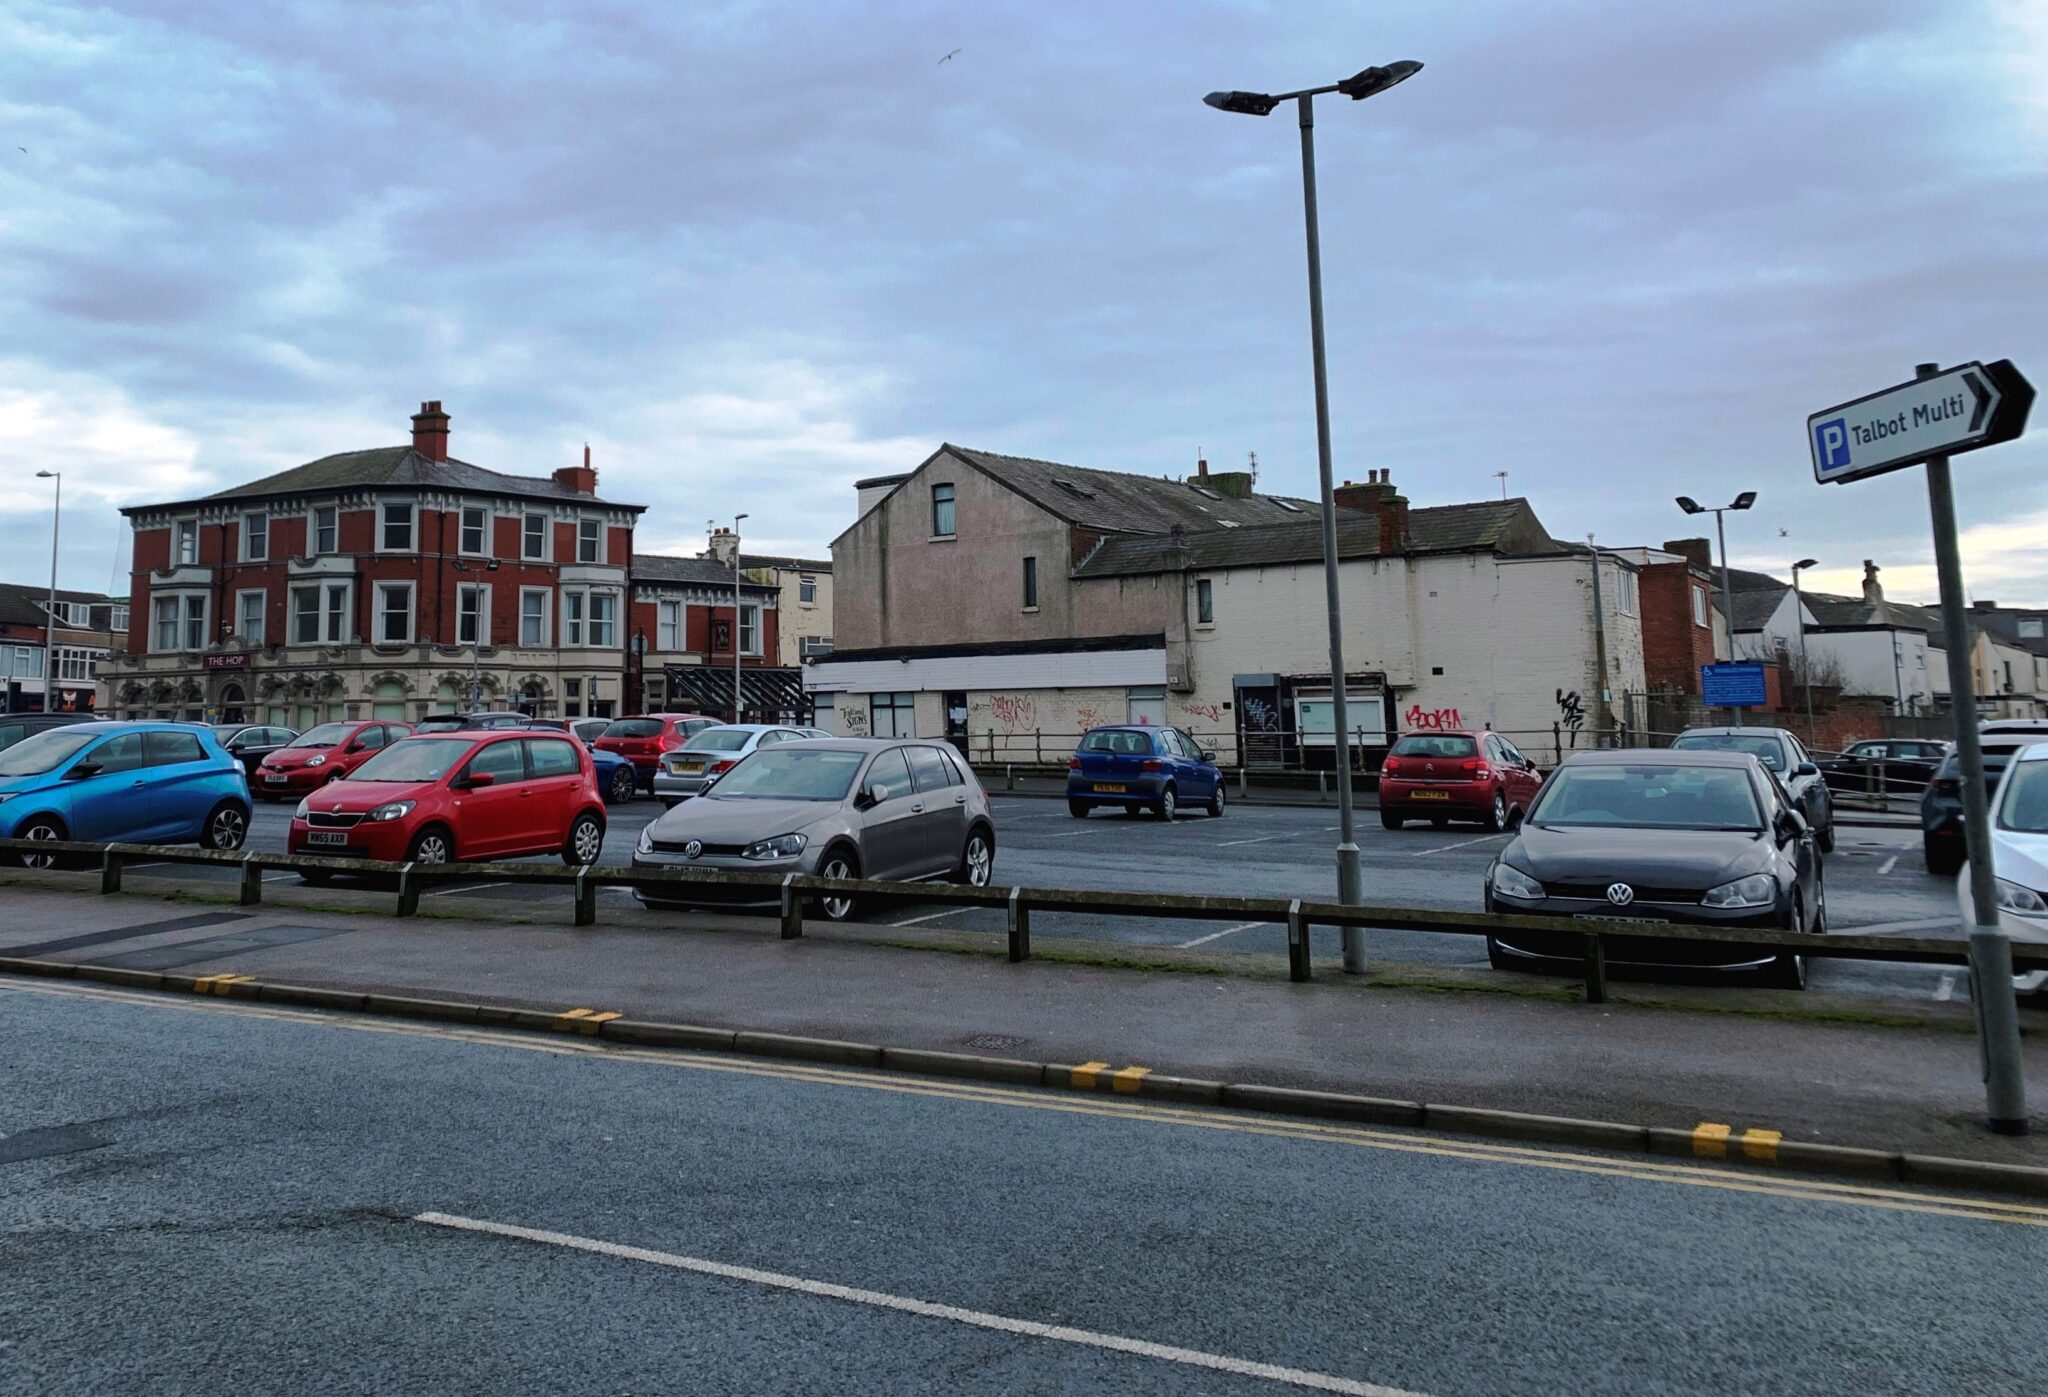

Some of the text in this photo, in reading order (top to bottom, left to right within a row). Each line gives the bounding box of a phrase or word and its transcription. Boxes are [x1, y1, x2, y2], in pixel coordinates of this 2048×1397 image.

[1822, 394, 1965, 465] P Talbot Multi
[208, 655, 244, 666] THE HOP
[330, 833, 345, 844] AXR
